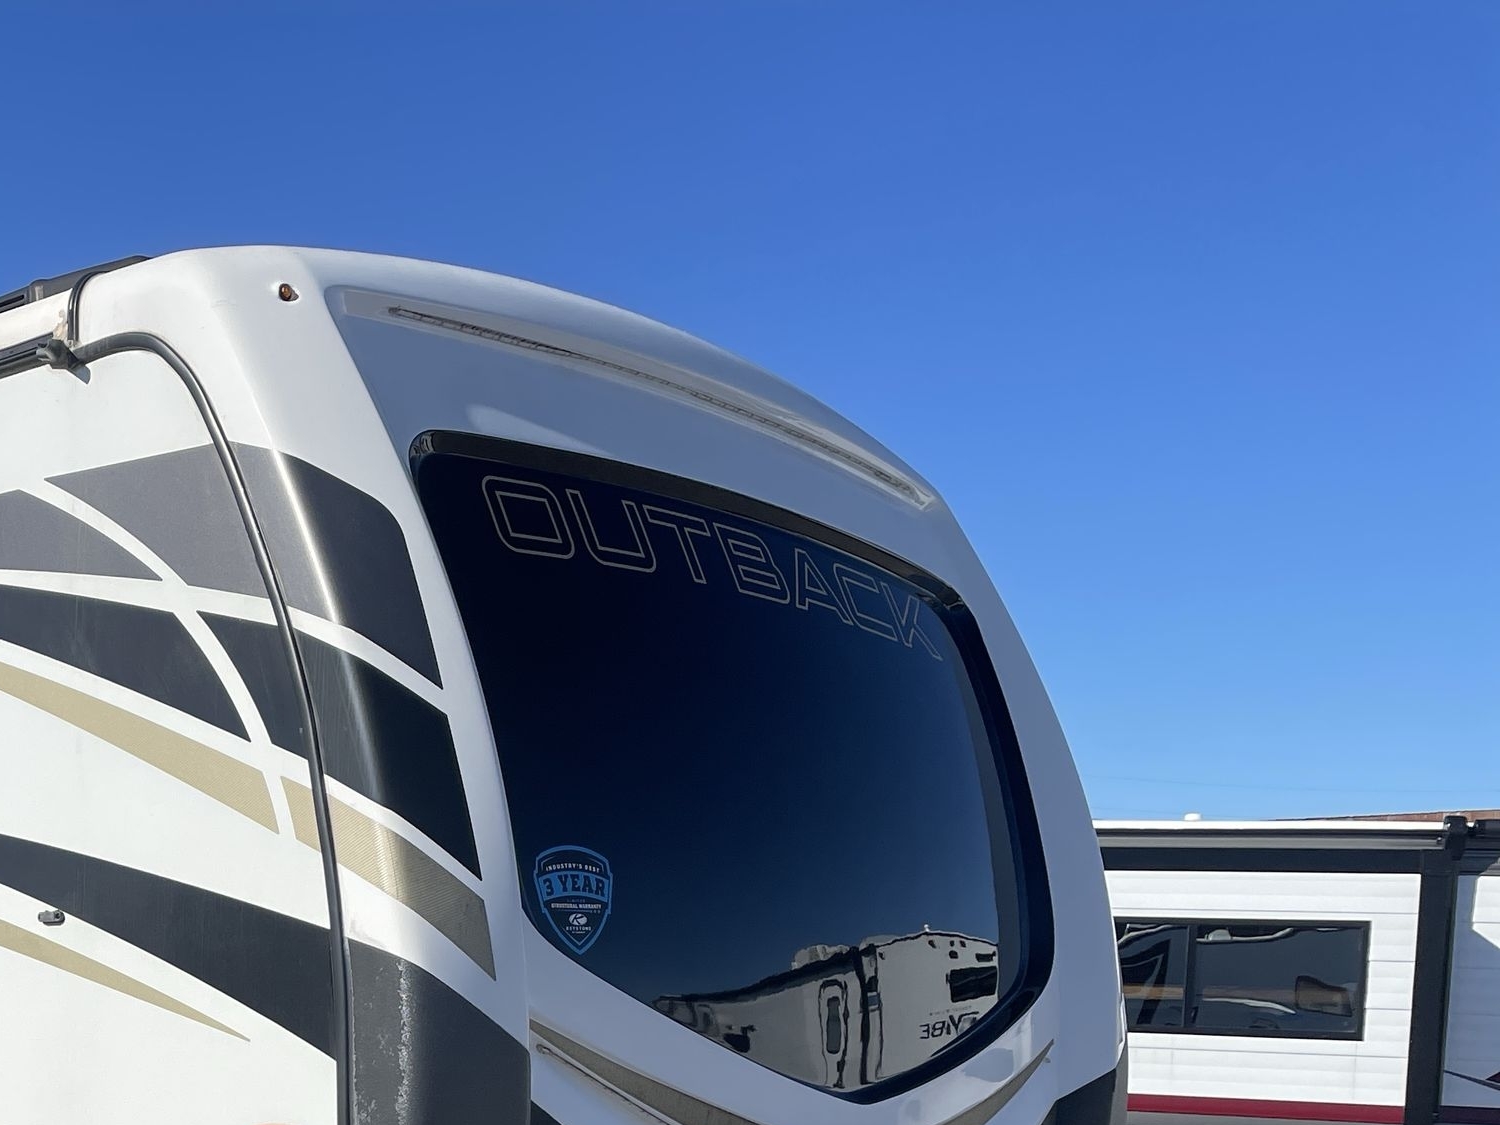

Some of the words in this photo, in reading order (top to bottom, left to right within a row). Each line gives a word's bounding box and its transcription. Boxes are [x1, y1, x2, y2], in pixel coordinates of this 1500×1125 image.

[482, 475, 943, 661] OUTBACK
[543, 877, 554, 897] 3
[557, 873, 605, 897] YEAR
